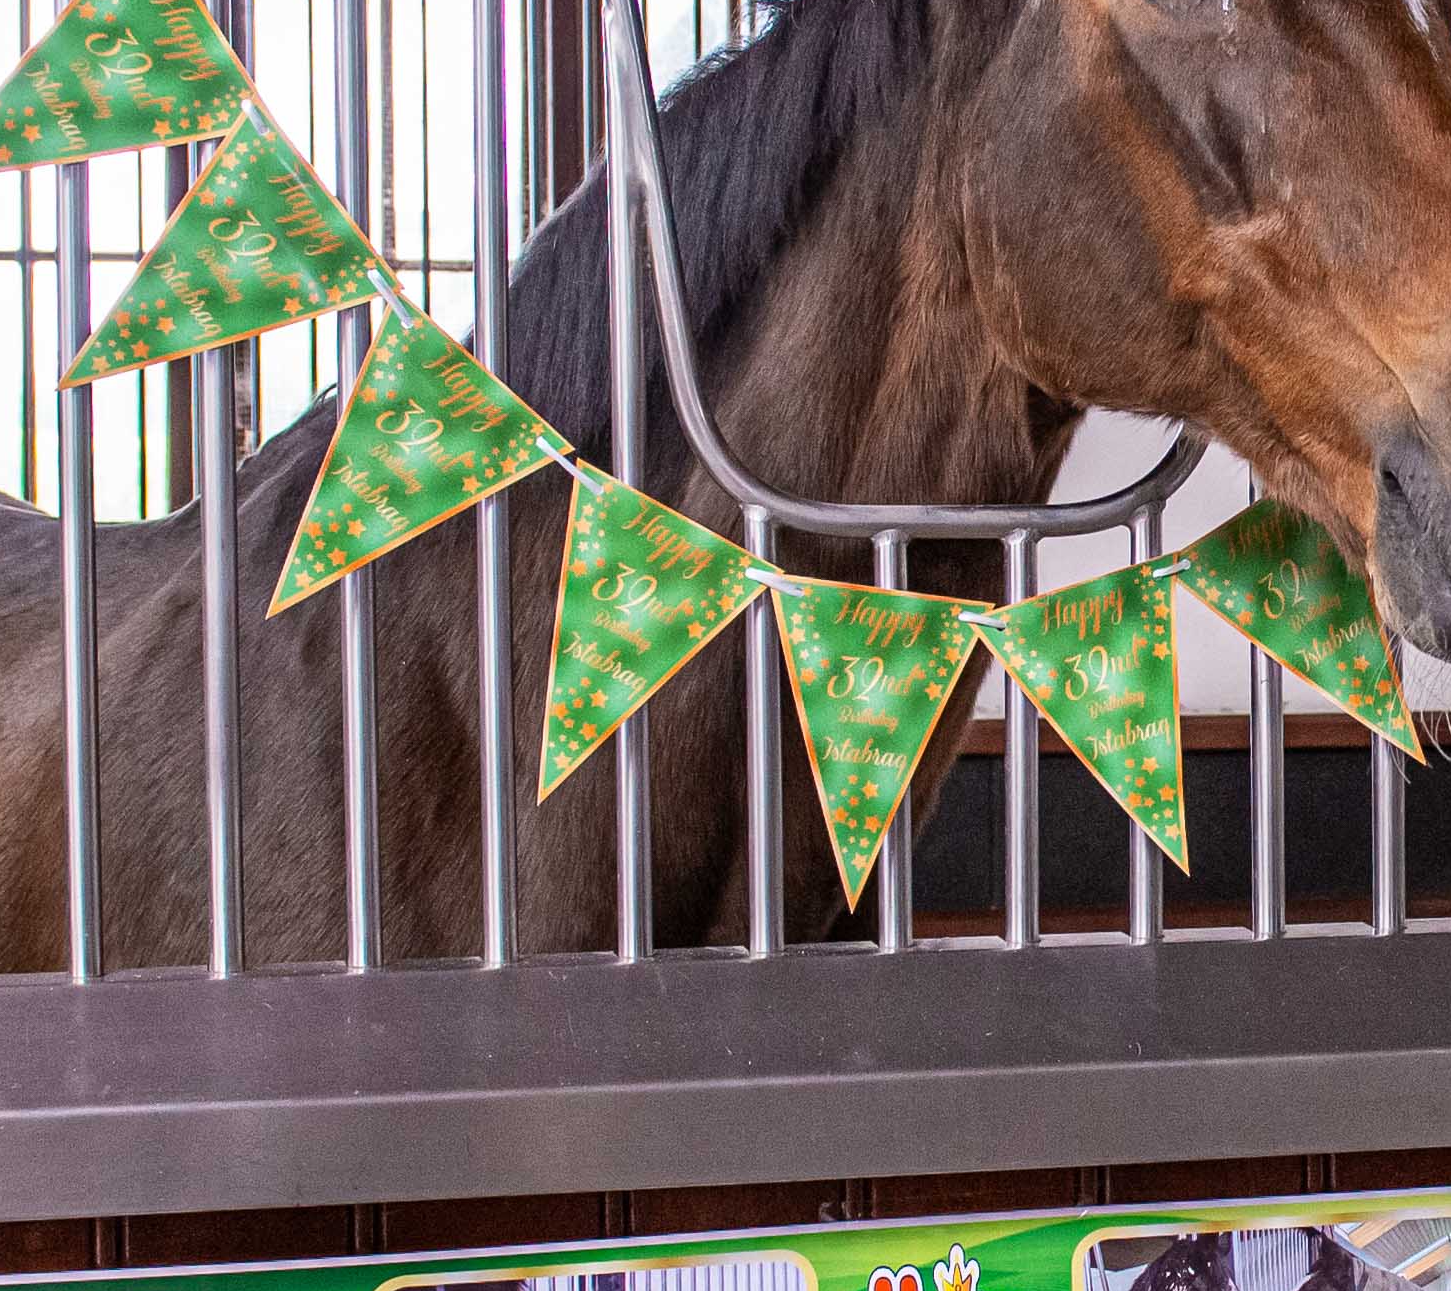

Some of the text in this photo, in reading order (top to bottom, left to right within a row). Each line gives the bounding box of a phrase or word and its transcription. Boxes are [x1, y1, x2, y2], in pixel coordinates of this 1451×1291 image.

[269, 162, 344, 256] Happy
[422, 342, 508, 433] Happy
[621, 499, 714, 579] Happy
[835, 592, 927, 648] Happy
[1035, 587, 1123, 640] Happy
